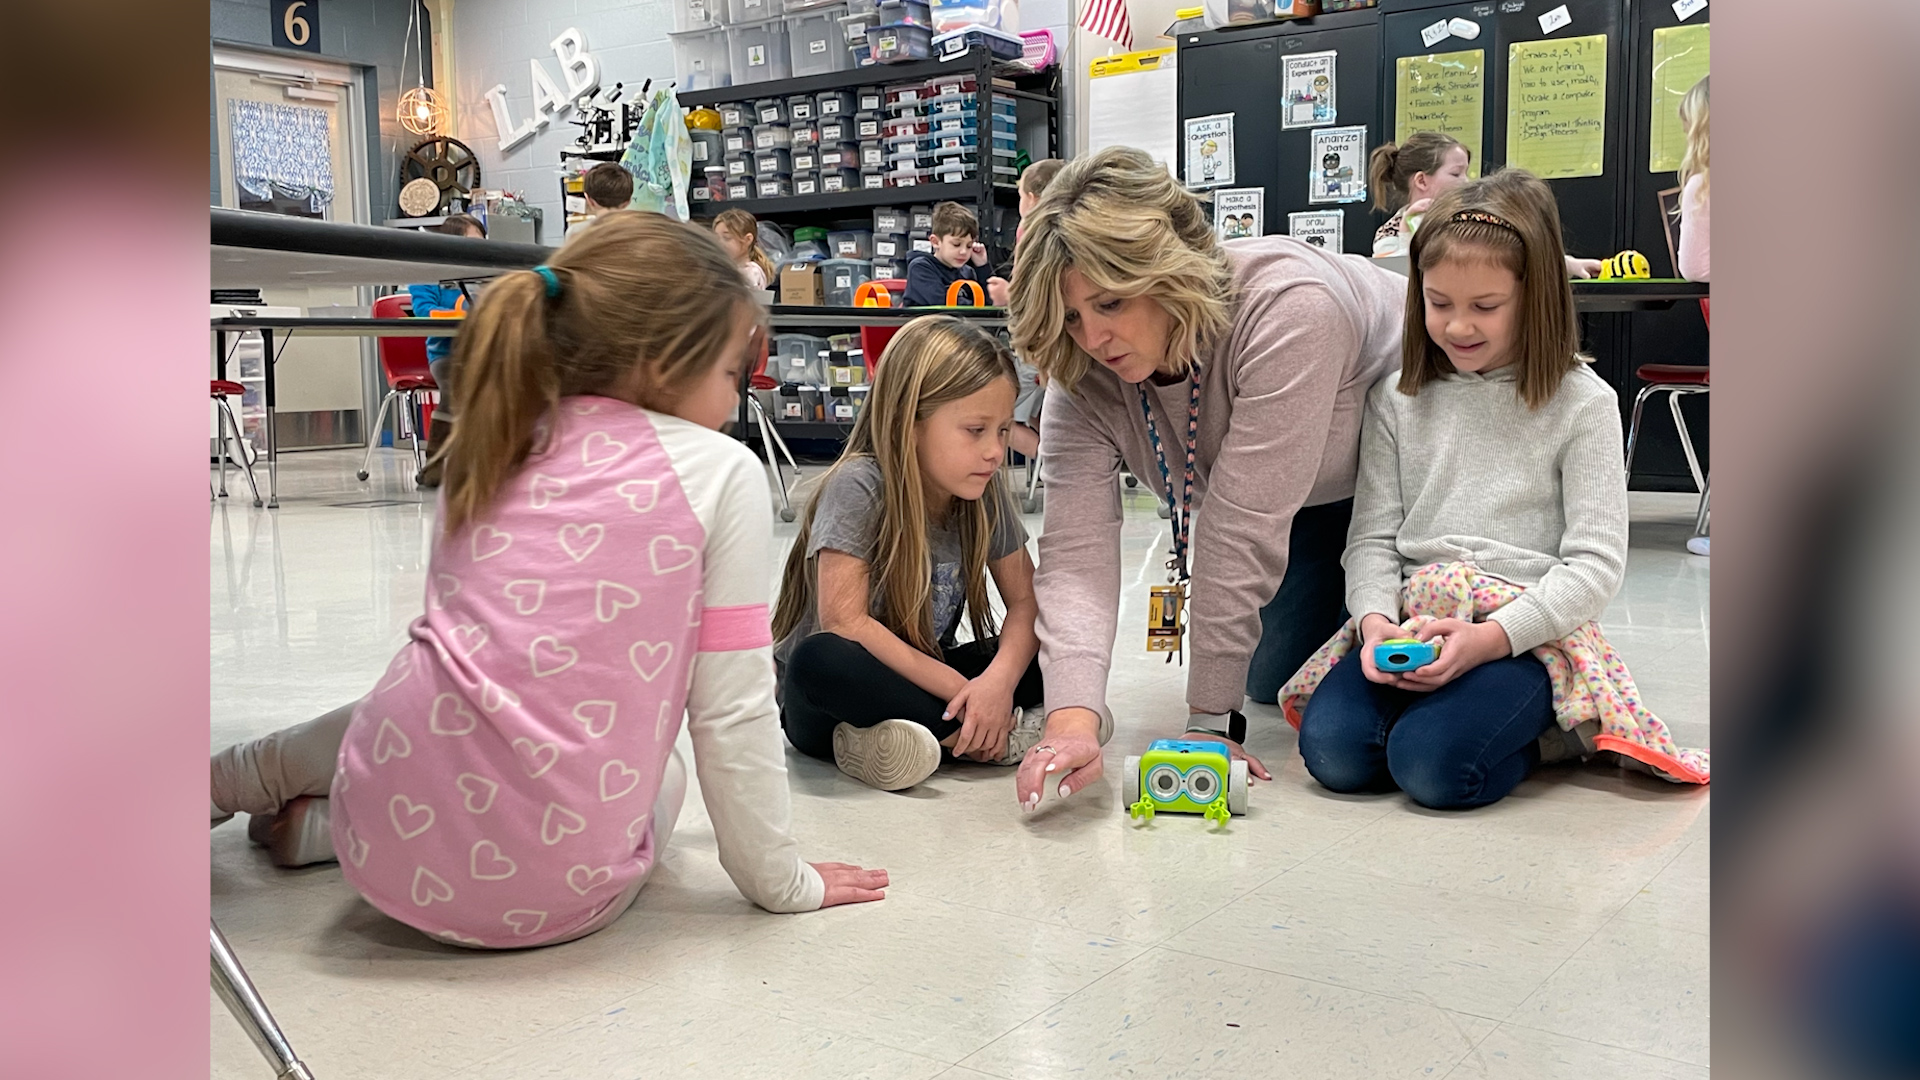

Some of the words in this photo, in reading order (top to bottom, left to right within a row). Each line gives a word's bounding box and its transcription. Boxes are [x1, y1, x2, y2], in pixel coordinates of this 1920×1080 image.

[284, 1, 310, 46] 6
[1290, 60, 1317, 70] Conduct
[1320, 58, 1329, 66] an
[1291, 67, 1326, 78] Experiment
[1540, 65, 1553, 73] are
[1425, 72, 1439, 80] are
[1540, 78, 1547, 87] to
[485, 27, 601, 153] LAB
[1214, 122, 1221, 130] a
[1191, 131, 1227, 141] Question
[1326, 144, 1349, 152] Data
[1220, 204, 1257, 212] Hypothesis
[1296, 228, 1336, 236] Conclusions
